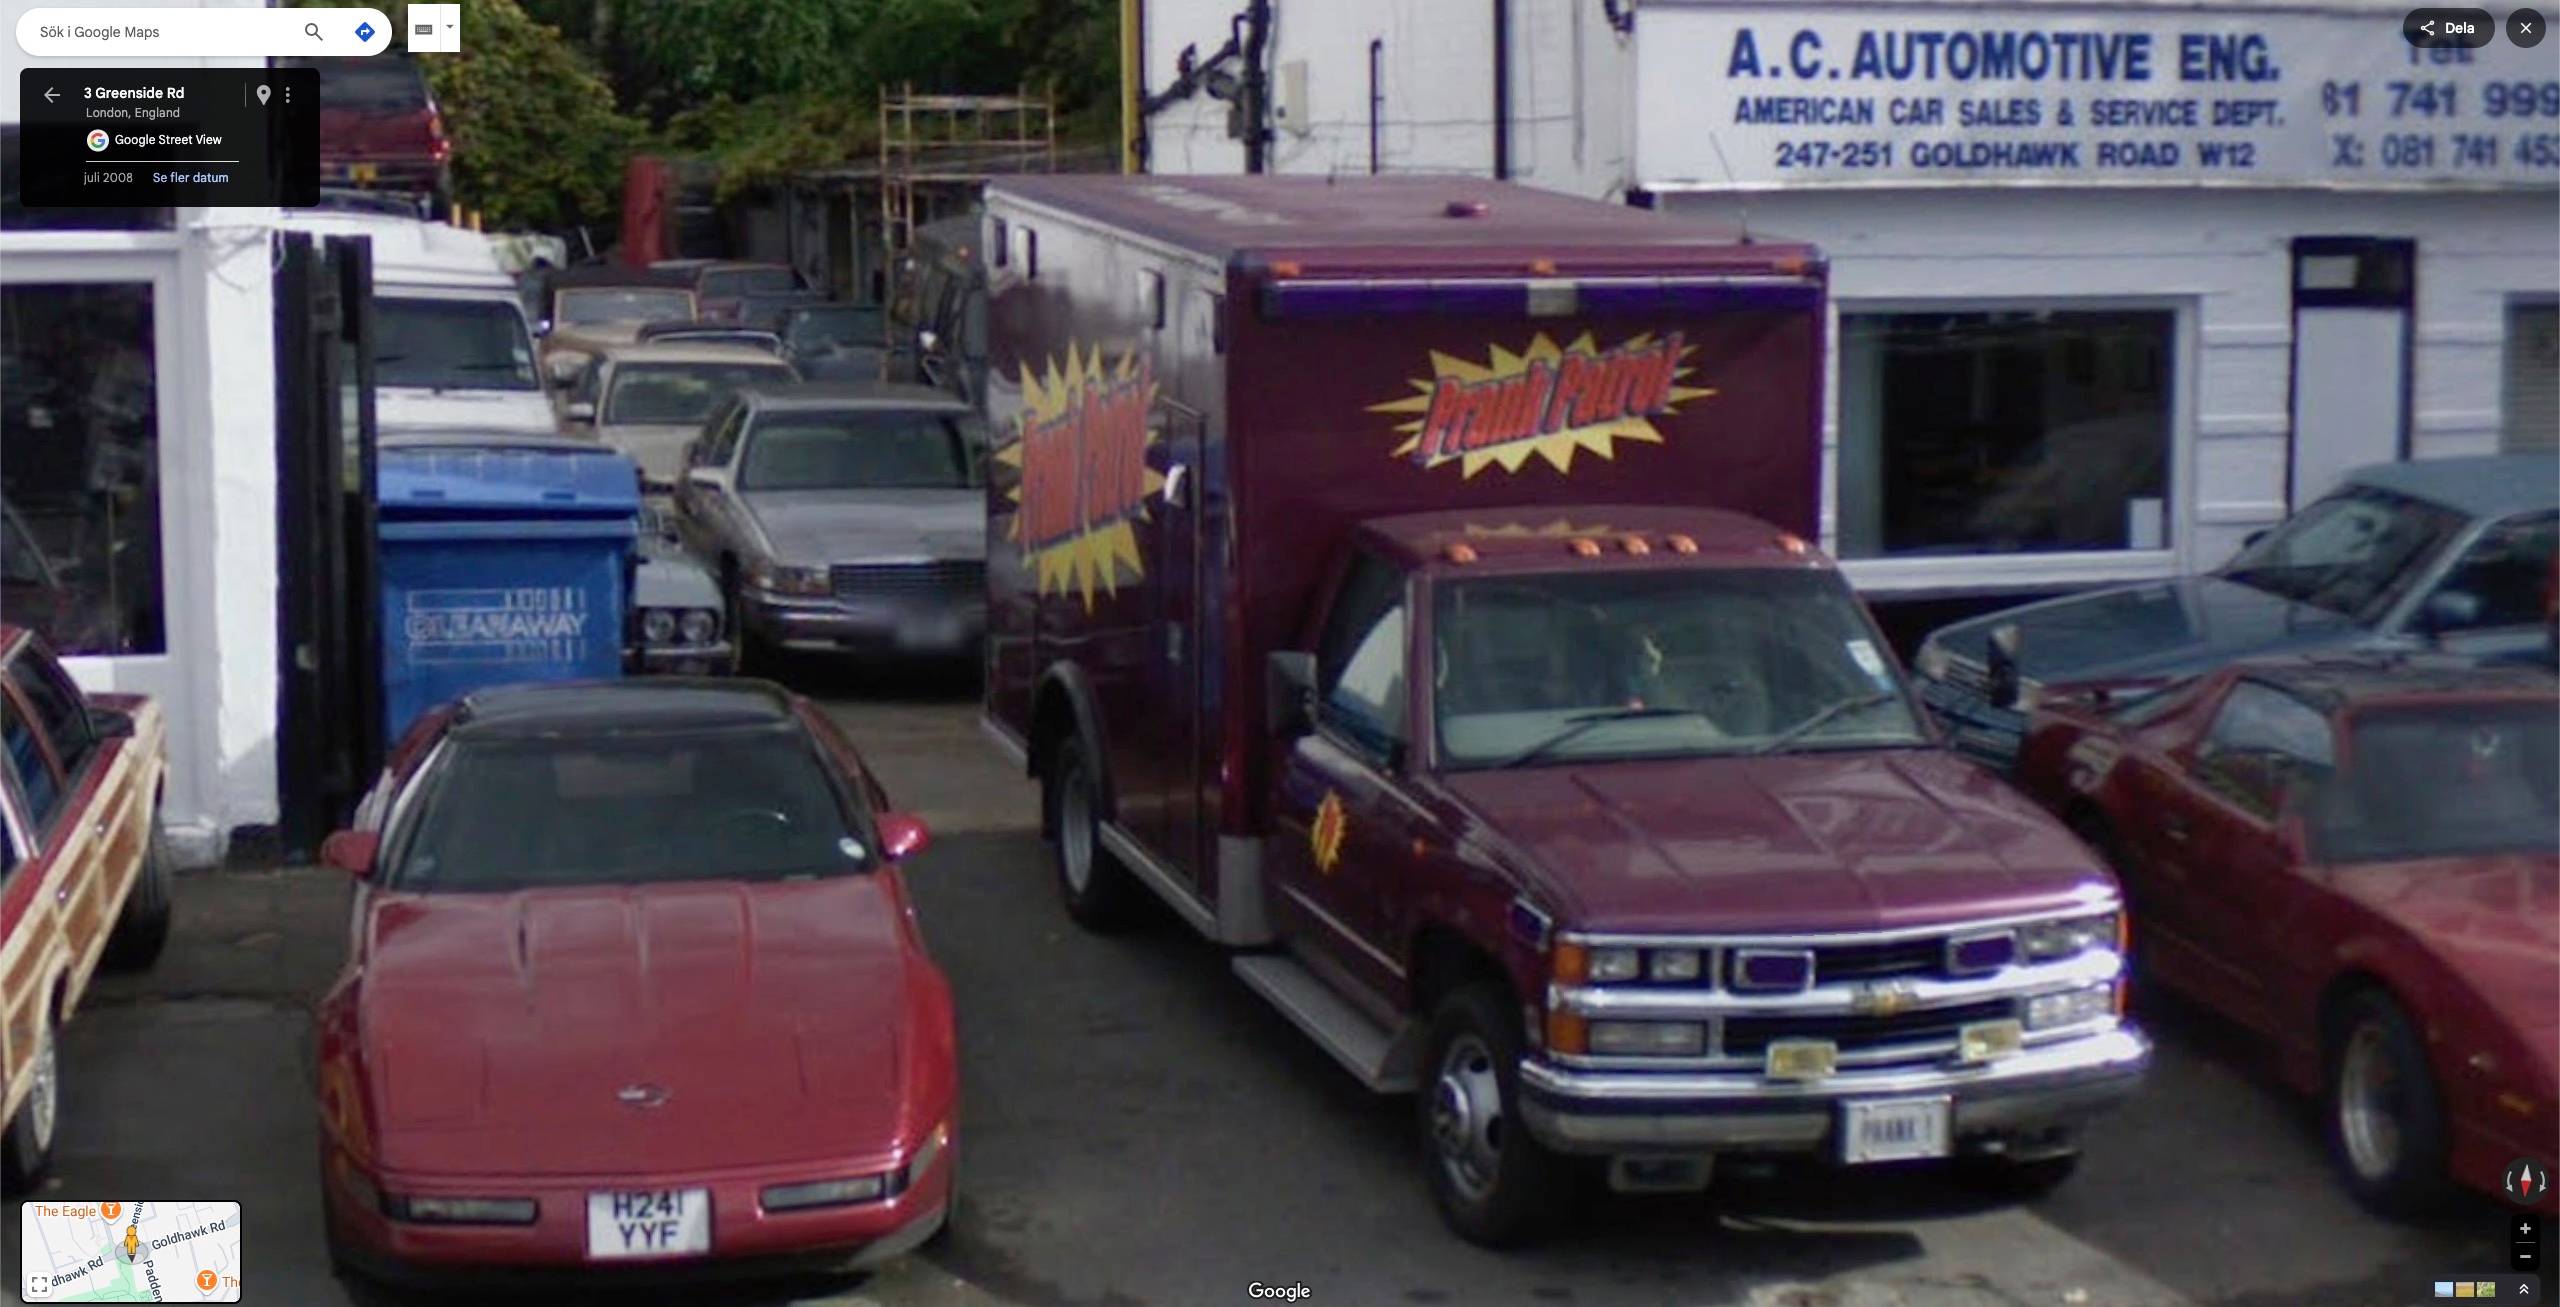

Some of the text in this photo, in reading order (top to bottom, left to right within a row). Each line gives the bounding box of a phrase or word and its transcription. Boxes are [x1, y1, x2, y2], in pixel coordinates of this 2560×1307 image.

[1851, 31, 2152, 80] AUTOMOTIVE
[2179, 33, 2280, 81] ENG.
[1734, 97, 2285, 127] AMERICAN CAR SALES & SERVICE DEPT.
[2385, 81, 2457, 118] 741
[1776, 141, 2256, 168] 247-251 GOLDHAWK ROAD W12
[2381, 134, 2434, 168] 081
[2452, 134, 2497, 167] 741
[619, 1220, 679, 1249] YYF
